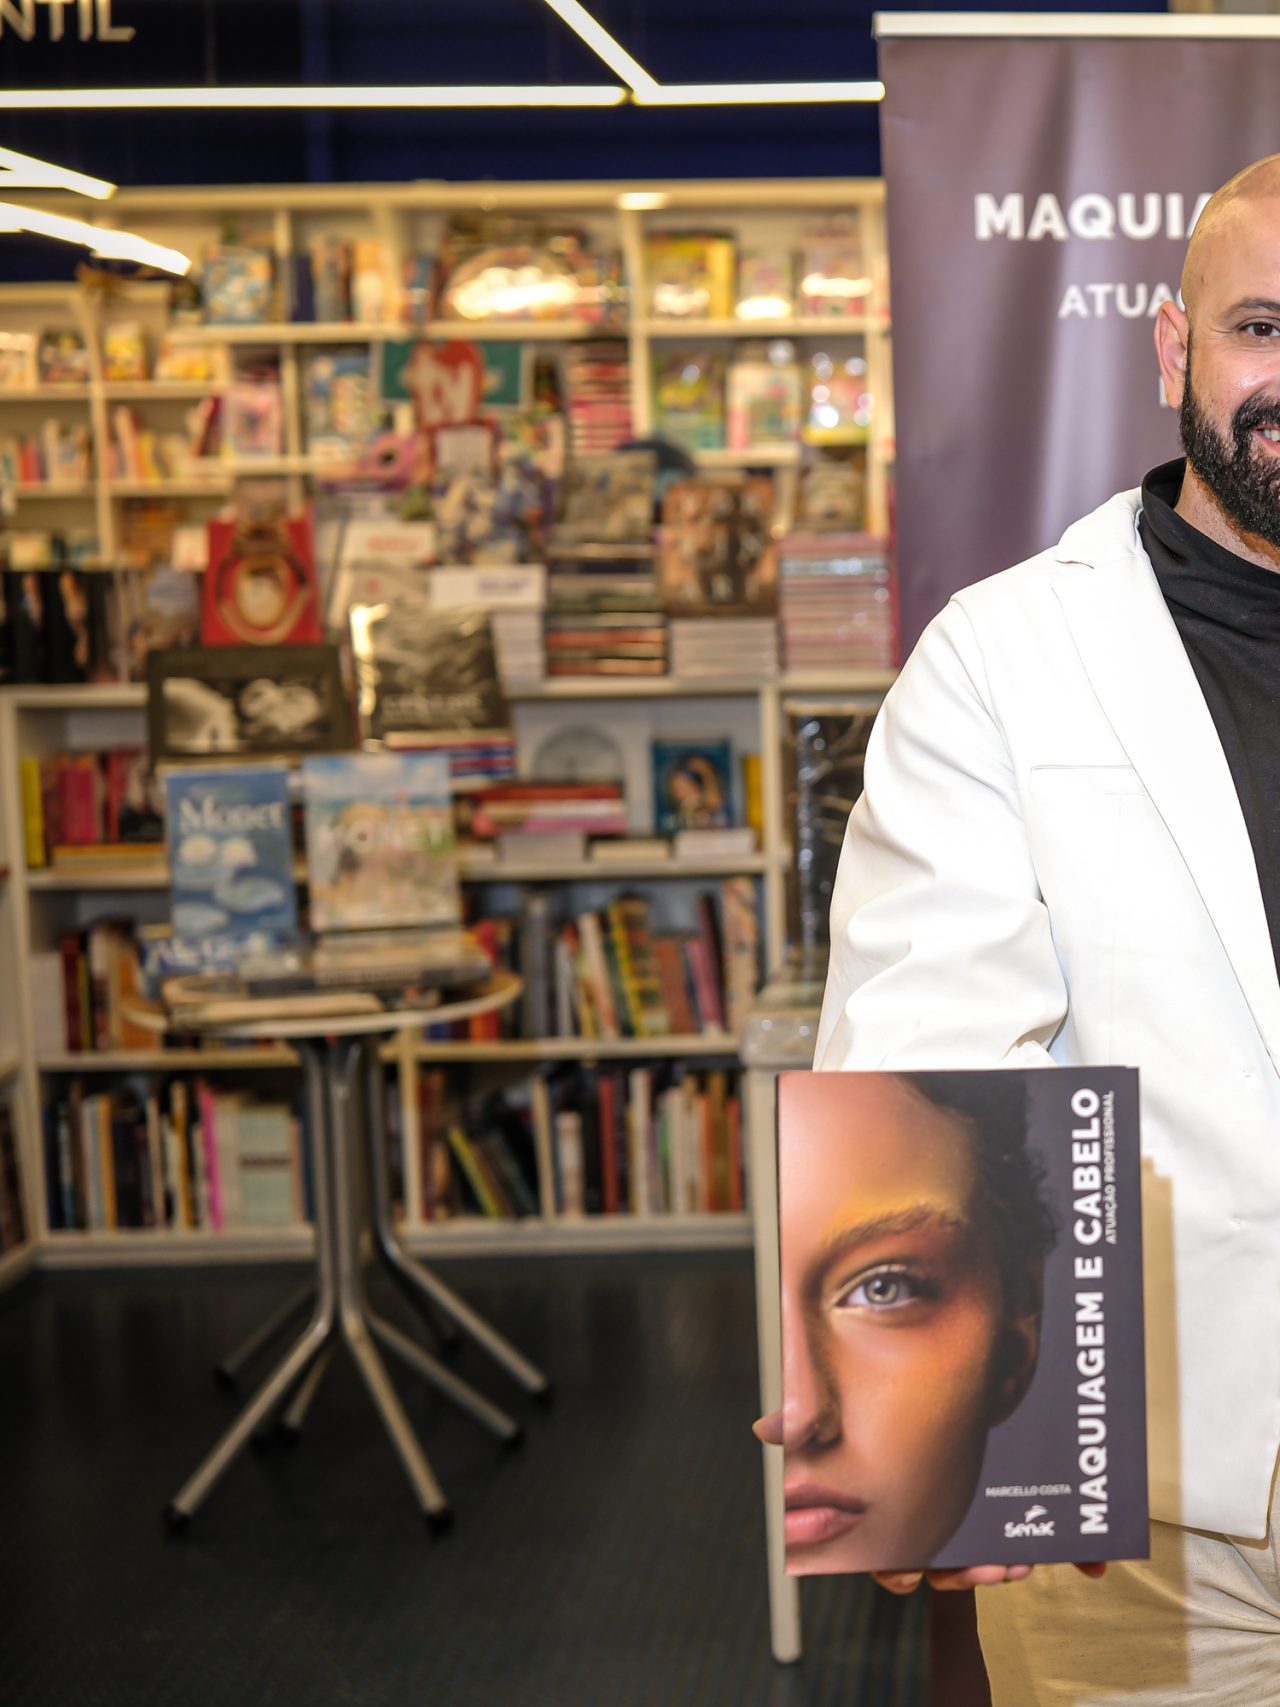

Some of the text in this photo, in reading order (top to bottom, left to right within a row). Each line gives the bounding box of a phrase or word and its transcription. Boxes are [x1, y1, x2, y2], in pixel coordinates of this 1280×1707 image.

[1103, 1090, 1116, 1182] PROFISSIONAL
[1071, 1088, 1109, 1535] MAQUIAGEM E CABELO
[985, 1483, 1072, 1498] MARCELLO COSTA
